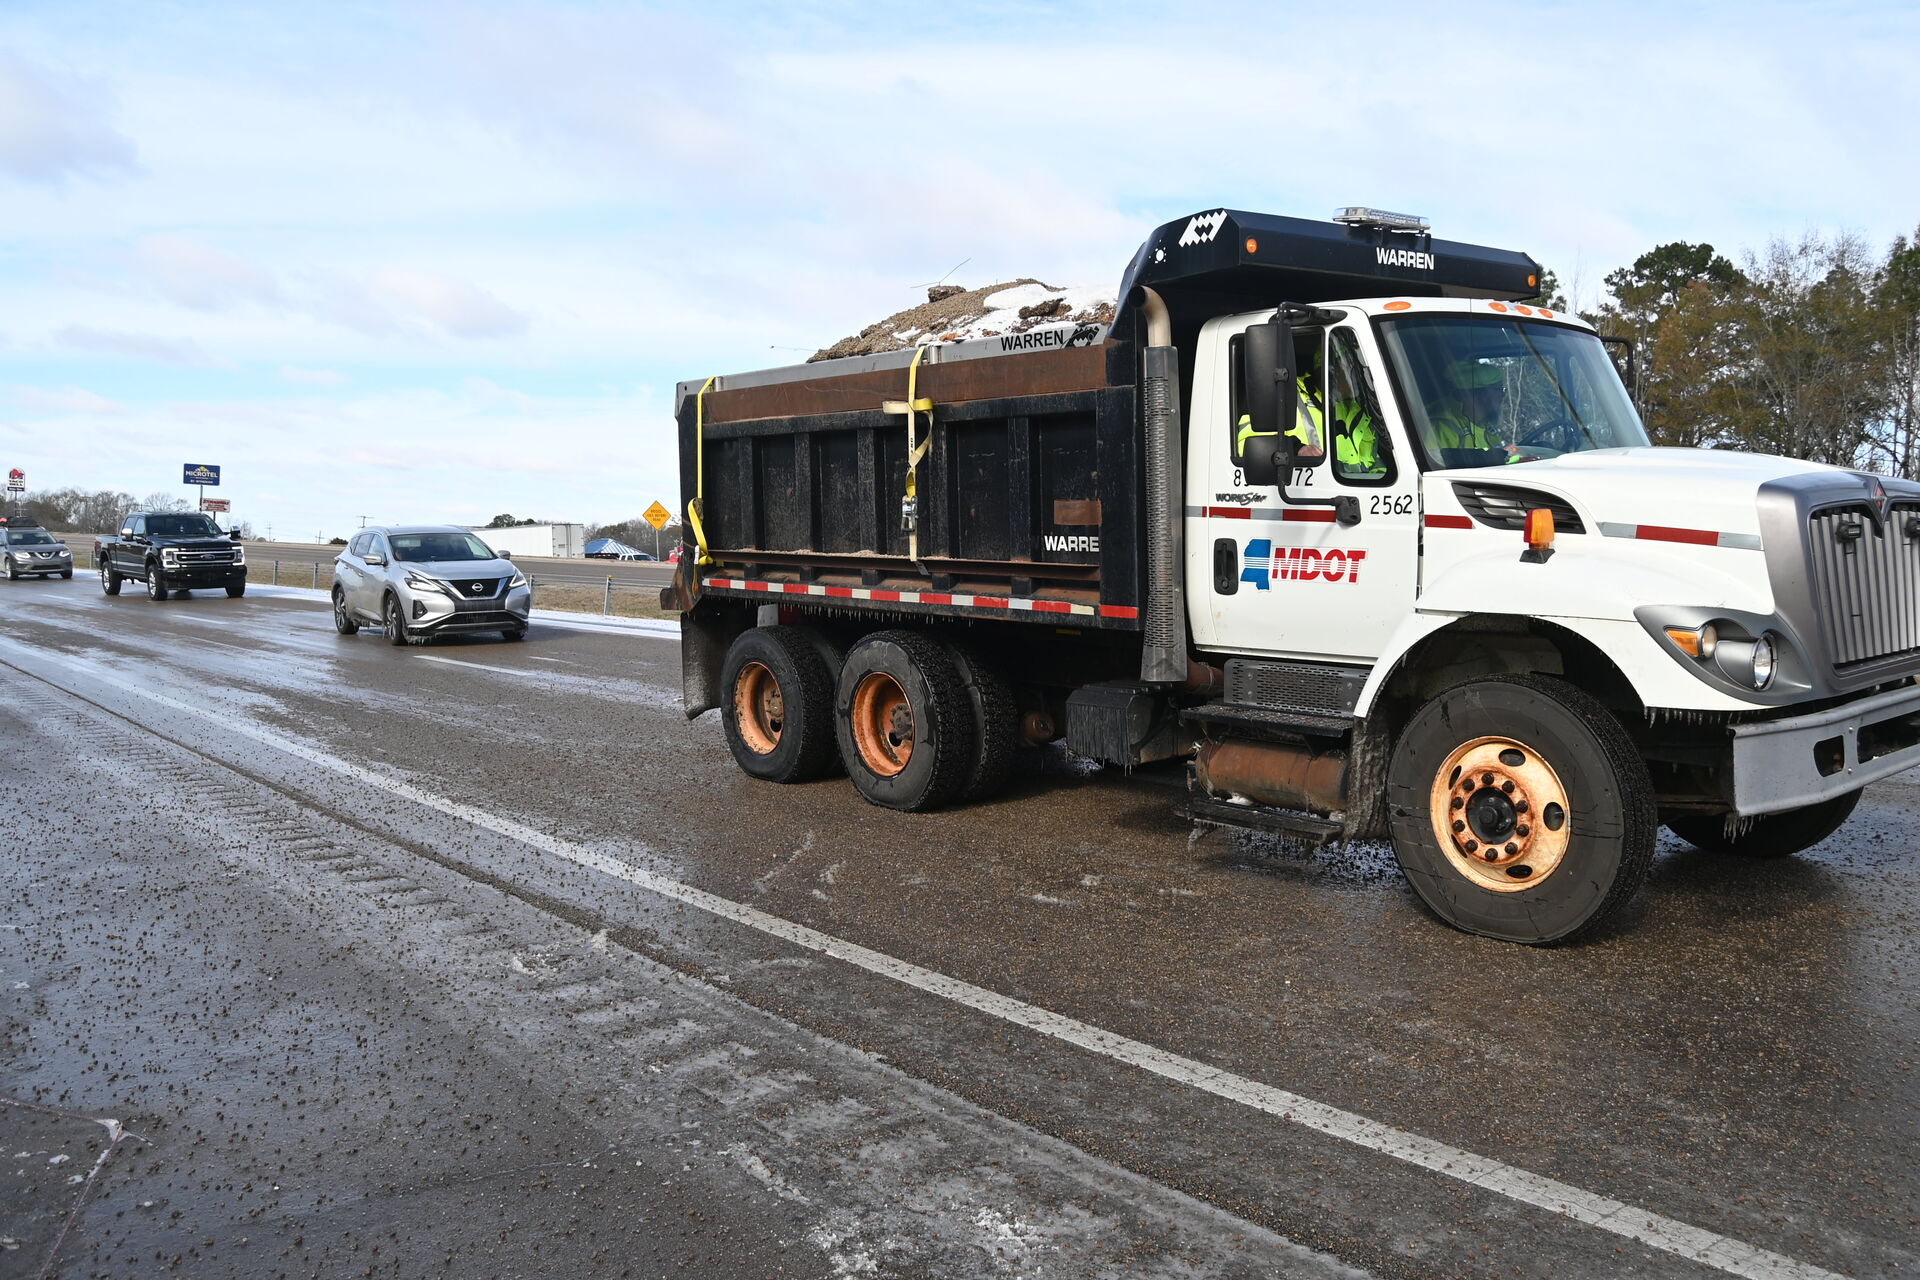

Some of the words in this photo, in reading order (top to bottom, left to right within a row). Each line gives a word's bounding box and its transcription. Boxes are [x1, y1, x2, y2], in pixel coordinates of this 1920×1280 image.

[1376, 247, 1435, 270] WARREN
[1000, 329, 1064, 351] WARREN
[185, 470, 218, 478] MICROTEL
[1370, 494, 1413, 515] 2562
[1044, 535, 1100, 552] WARRE
[1272, 547, 1367, 583] MDOT
